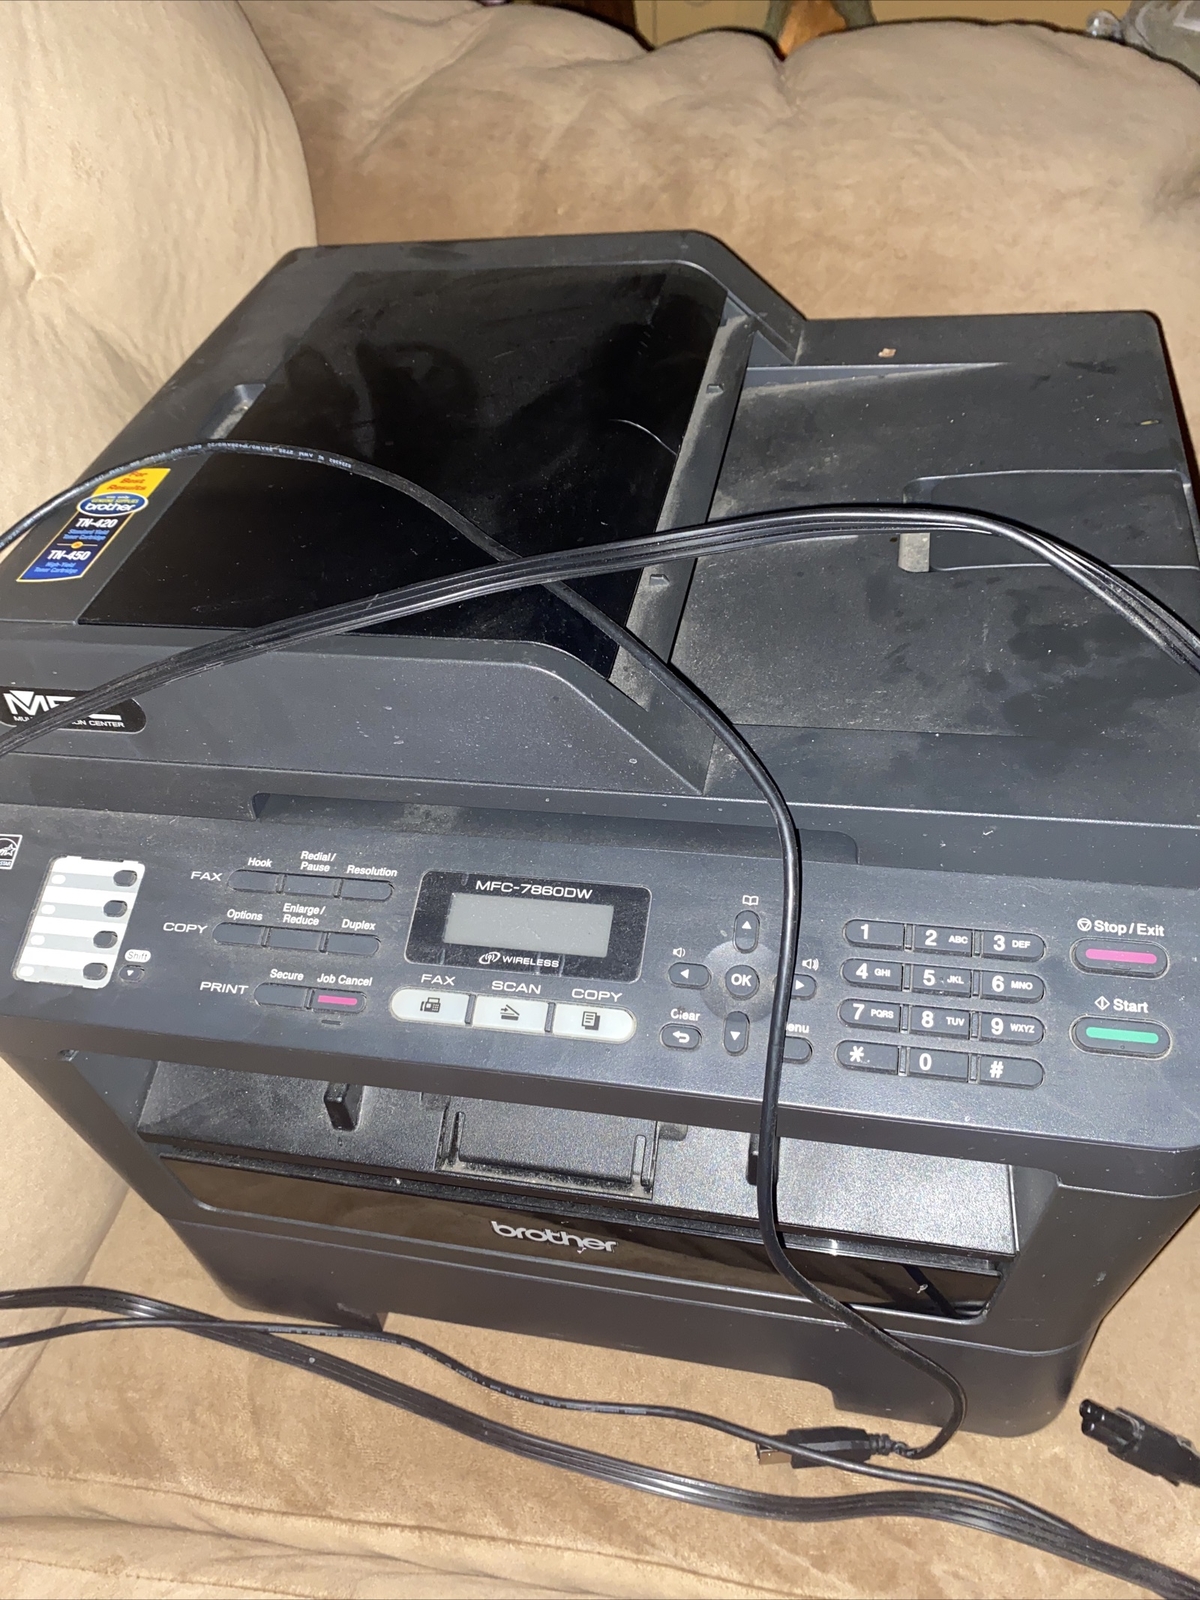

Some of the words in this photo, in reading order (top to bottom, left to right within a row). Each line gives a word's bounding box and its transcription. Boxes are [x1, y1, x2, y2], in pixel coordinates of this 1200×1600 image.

[85, 502, 136, 512] brother
[75, 518, 118, 528] TN-420
[47, 550, 91, 561] TN-450
[88, 720, 125, 728] CENTER
[247, 858, 272, 868] Hook
[300, 861, 330, 873] Pause
[191, 870, 223, 882] FAX
[346, 864, 398, 877] Resolution
[476, 880, 593, 900] MFC-7860DW
[226, 909, 263, 921] Options
[282, 914, 320, 926] Reduce
[162, 922, 208, 934] COPY
[341, 918, 376, 932] Duplex
[860, 924, 869, 940] 1
[925, 930, 937, 946] 2
[948, 935, 969, 945] ABC
[993, 935, 1006, 951] 3
[1012, 940, 1031, 949] DEF
[127, 951, 148, 961] Shift
[502, 955, 560, 968] WIRELESS
[270, 969, 304, 982] Secure
[855, 963, 868, 979] 4
[874, 968, 891, 977] GHI
[923, 969, 935, 986] 5
[947, 975, 965, 984] JKL
[316, 973, 335, 985] Job
[337, 975, 372, 987] Cancel
[420, 973, 456, 986] FAX
[731, 974, 752, 987] OK
[991, 975, 1004, 992] 6
[1010, 980, 1034, 990] MNO
[199, 981, 249, 995] PRINT
[491, 980, 542, 995] SCAN
[571, 988, 623, 1002] COPY
[852, 1003, 865, 1020] 7
[870, 1009, 894, 1019] PQRS
[1113, 998, 1149, 1013] Start
[670, 1008, 701, 1021] Clear
[921, 1011, 934, 1028] 8
[946, 1016, 965, 1026] TUV
[785, 1019, 810, 1033] enu
[991, 1018, 1004, 1035] 9
[1010, 1023, 1035, 1034] WXYZ
[919, 1053, 932, 1071] 0
[491, 1220, 617, 1252] brother
